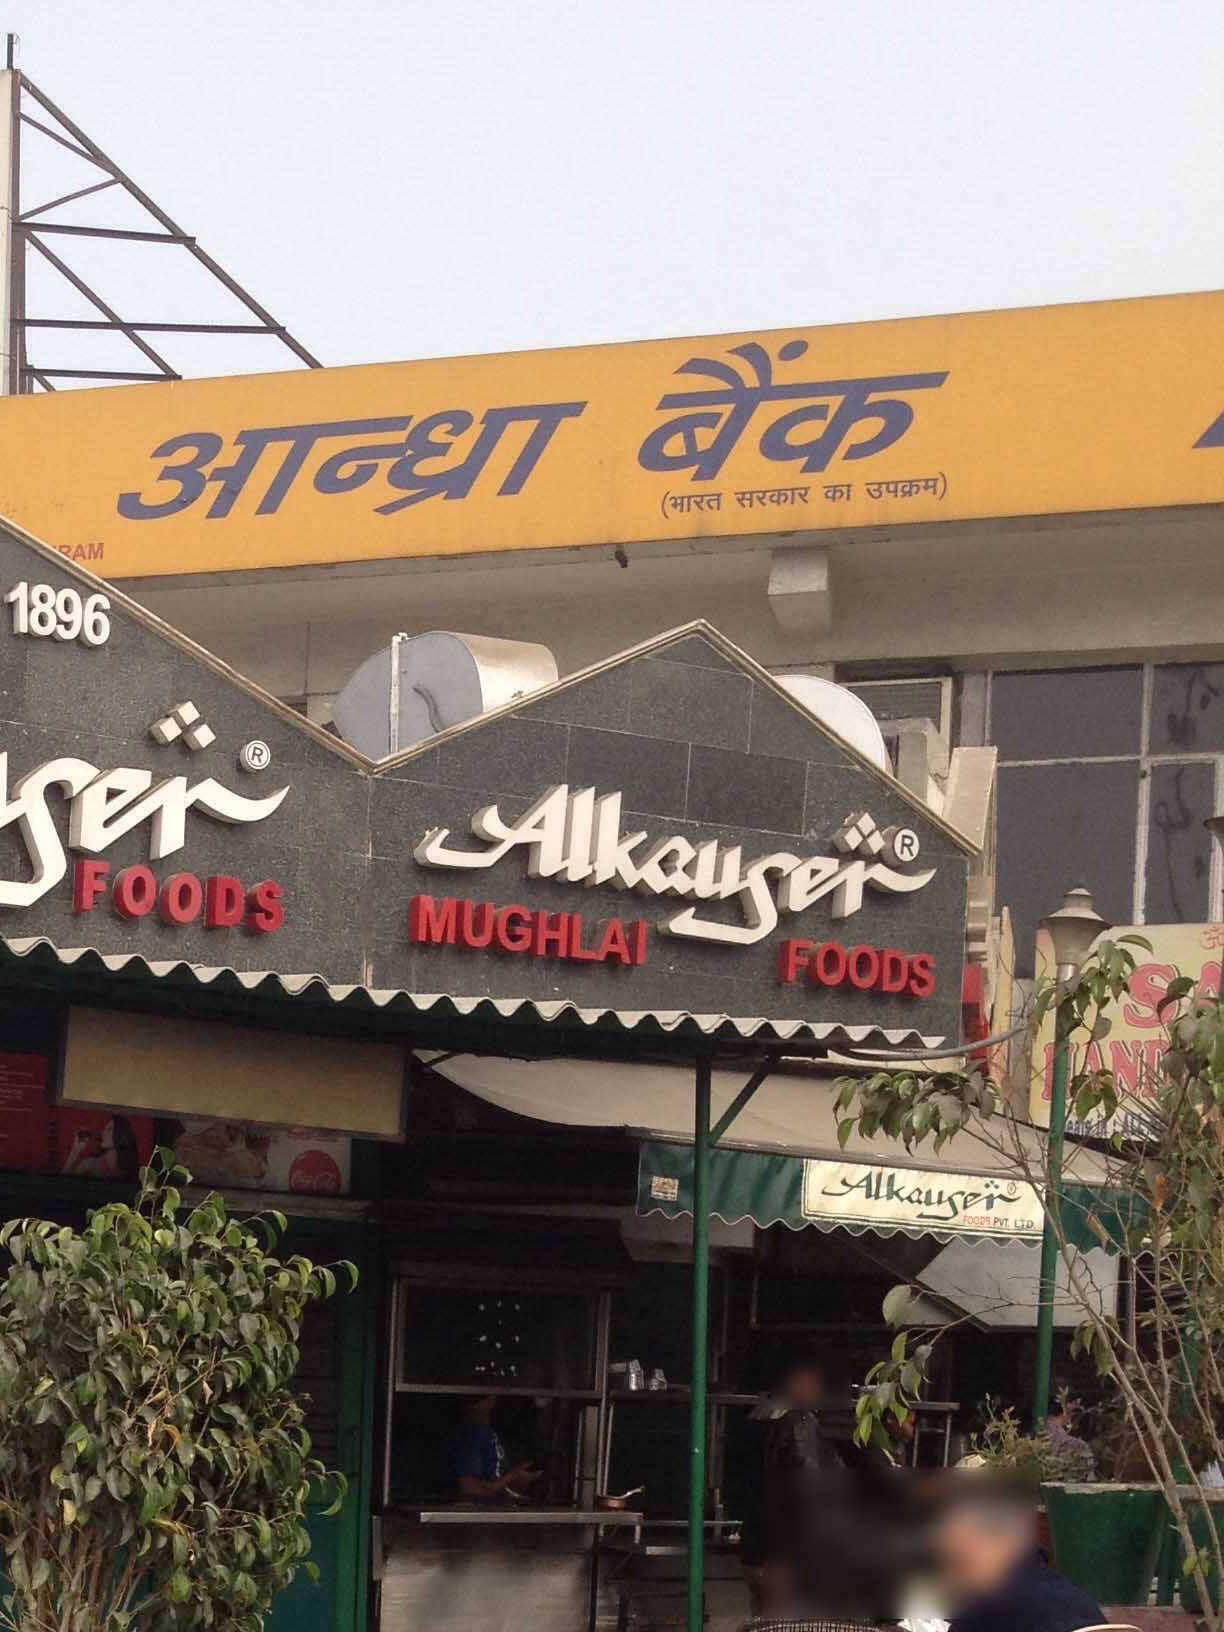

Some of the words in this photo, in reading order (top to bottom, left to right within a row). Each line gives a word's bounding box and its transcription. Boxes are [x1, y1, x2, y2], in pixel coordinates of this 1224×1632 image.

[116, 400, 588, 520] आन्ध्रा
[638, 339, 950, 481] बैंक
[735, 486, 810, 508] सरकार
[824, 483, 852, 502] का
[52, 543, 104, 561] RAM
[5, 581, 111, 648] 1896
[72, 858, 284, 934] FOODS
[415, 784, 936, 945] Alkauser
[409, 894, 647, 967] MUGHLAI
[777, 938, 936, 996] FOODS
[822, 1170, 1021, 1221] Alkauser
[963, 1215, 991, 1227] FOODS
